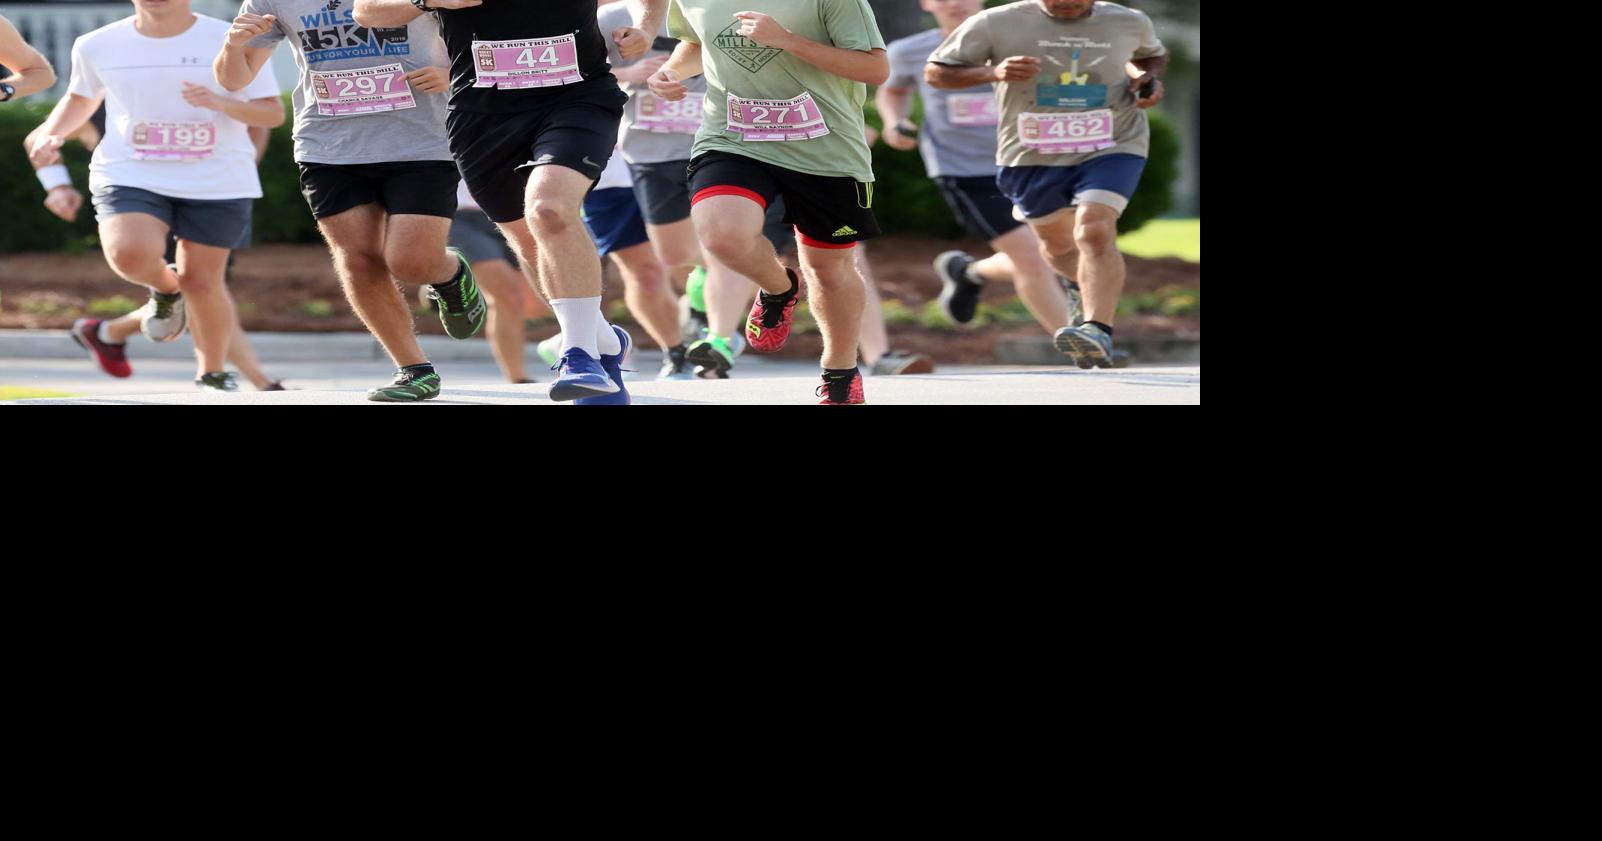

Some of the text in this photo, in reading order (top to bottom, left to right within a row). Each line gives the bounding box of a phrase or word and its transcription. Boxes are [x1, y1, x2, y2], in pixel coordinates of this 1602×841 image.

[319, 24, 361, 49] 5K
[324, 50, 343, 59] FOR
[344, 48, 376, 56] YOUR
[388, 45, 409, 53] LIFE
[516, 46, 560, 68] 44
[480, 58, 494, 66] 5K
[335, 73, 395, 97] 297
[793, 94, 809, 104] MILL
[750, 103, 809, 124] 271
[158, 127, 211, 146] 199
[1048, 119, 1105, 137] 462
